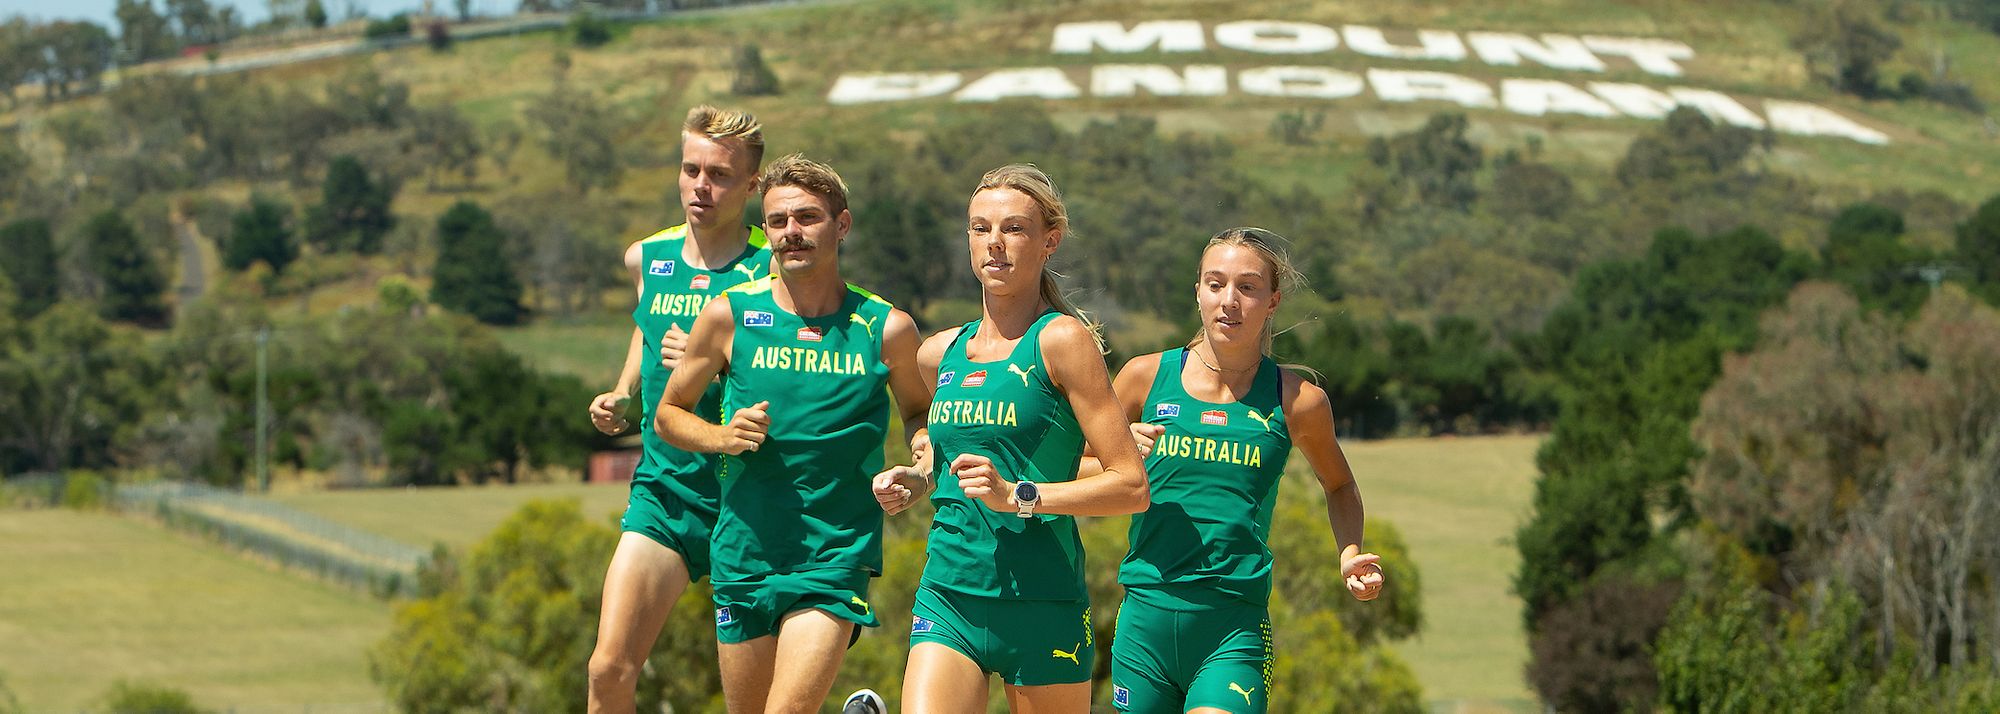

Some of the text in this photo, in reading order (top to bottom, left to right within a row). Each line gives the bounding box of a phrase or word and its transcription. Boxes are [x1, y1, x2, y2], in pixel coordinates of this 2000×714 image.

[1051, 19, 1695, 77] MOUNT
[827, 63, 1890, 145] PANORAMA
[751, 346, 867, 376] AUSTRALIA
[1156, 434, 1261, 468] AUSTRALIA
